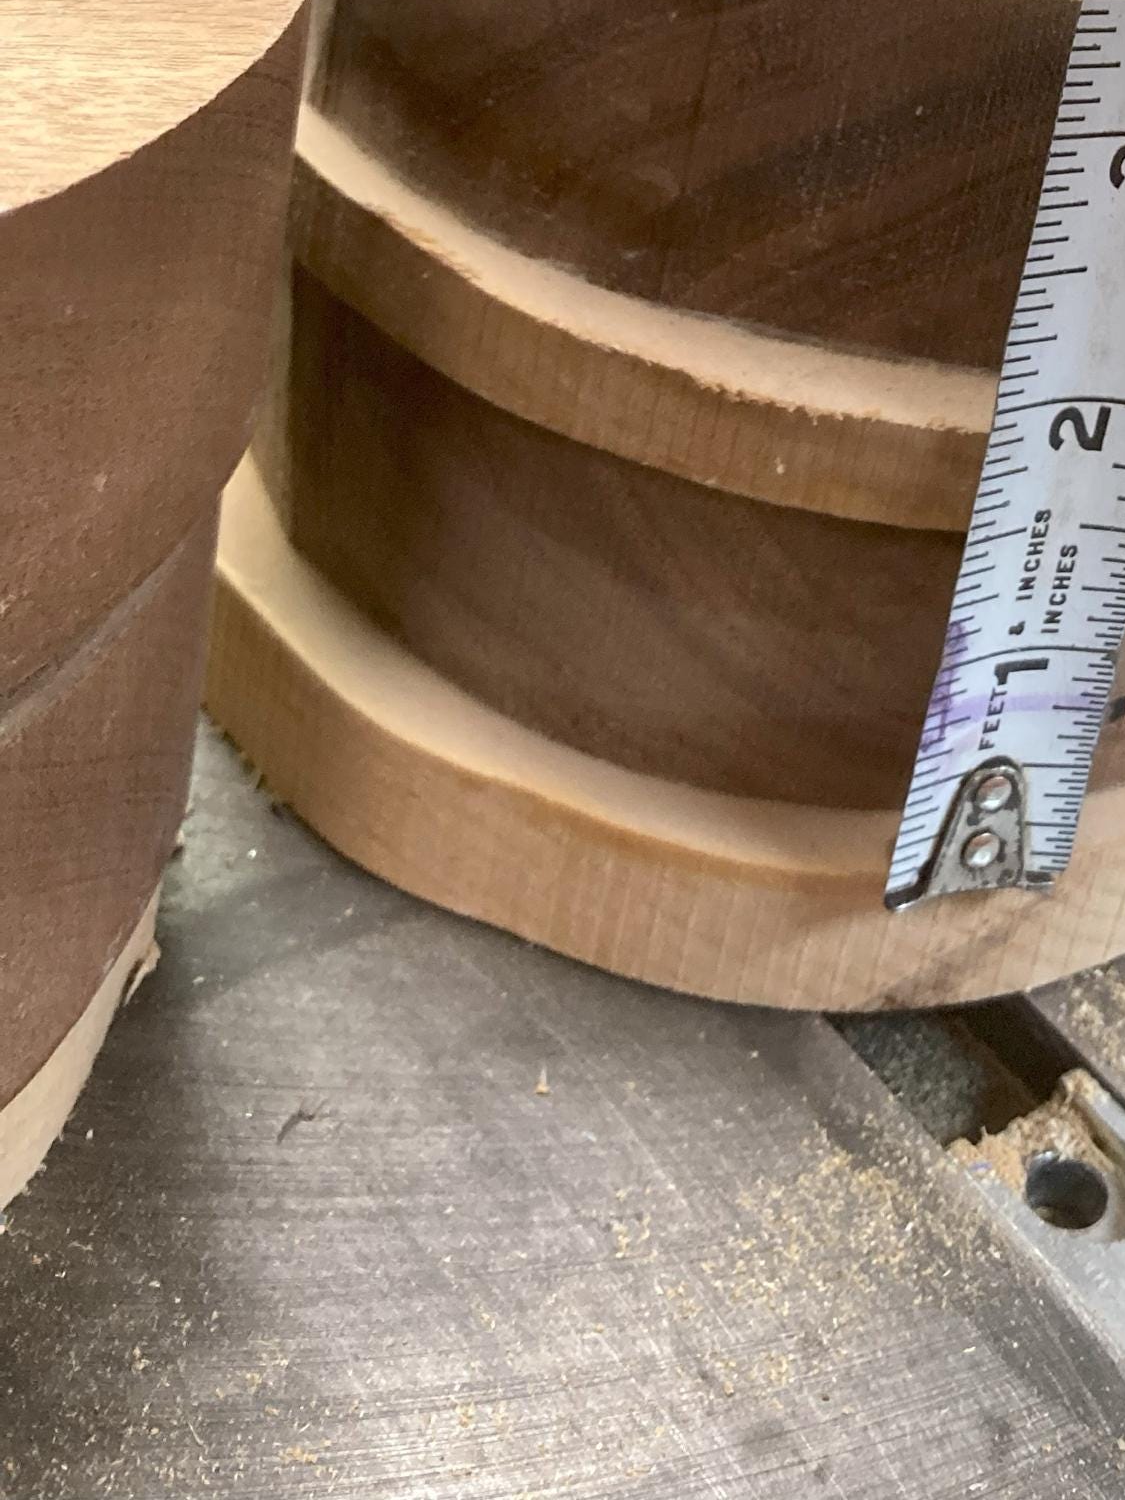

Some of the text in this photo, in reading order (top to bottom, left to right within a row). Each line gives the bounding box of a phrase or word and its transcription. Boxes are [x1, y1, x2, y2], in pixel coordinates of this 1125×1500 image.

[1049, 406, 1111, 451] 2
[1041, 544, 1078, 634] INCHES
[978, 688, 1007, 750] FEET
[1016, 509, 1052, 601] INCHES
[994, 658, 1049, 685] 1
